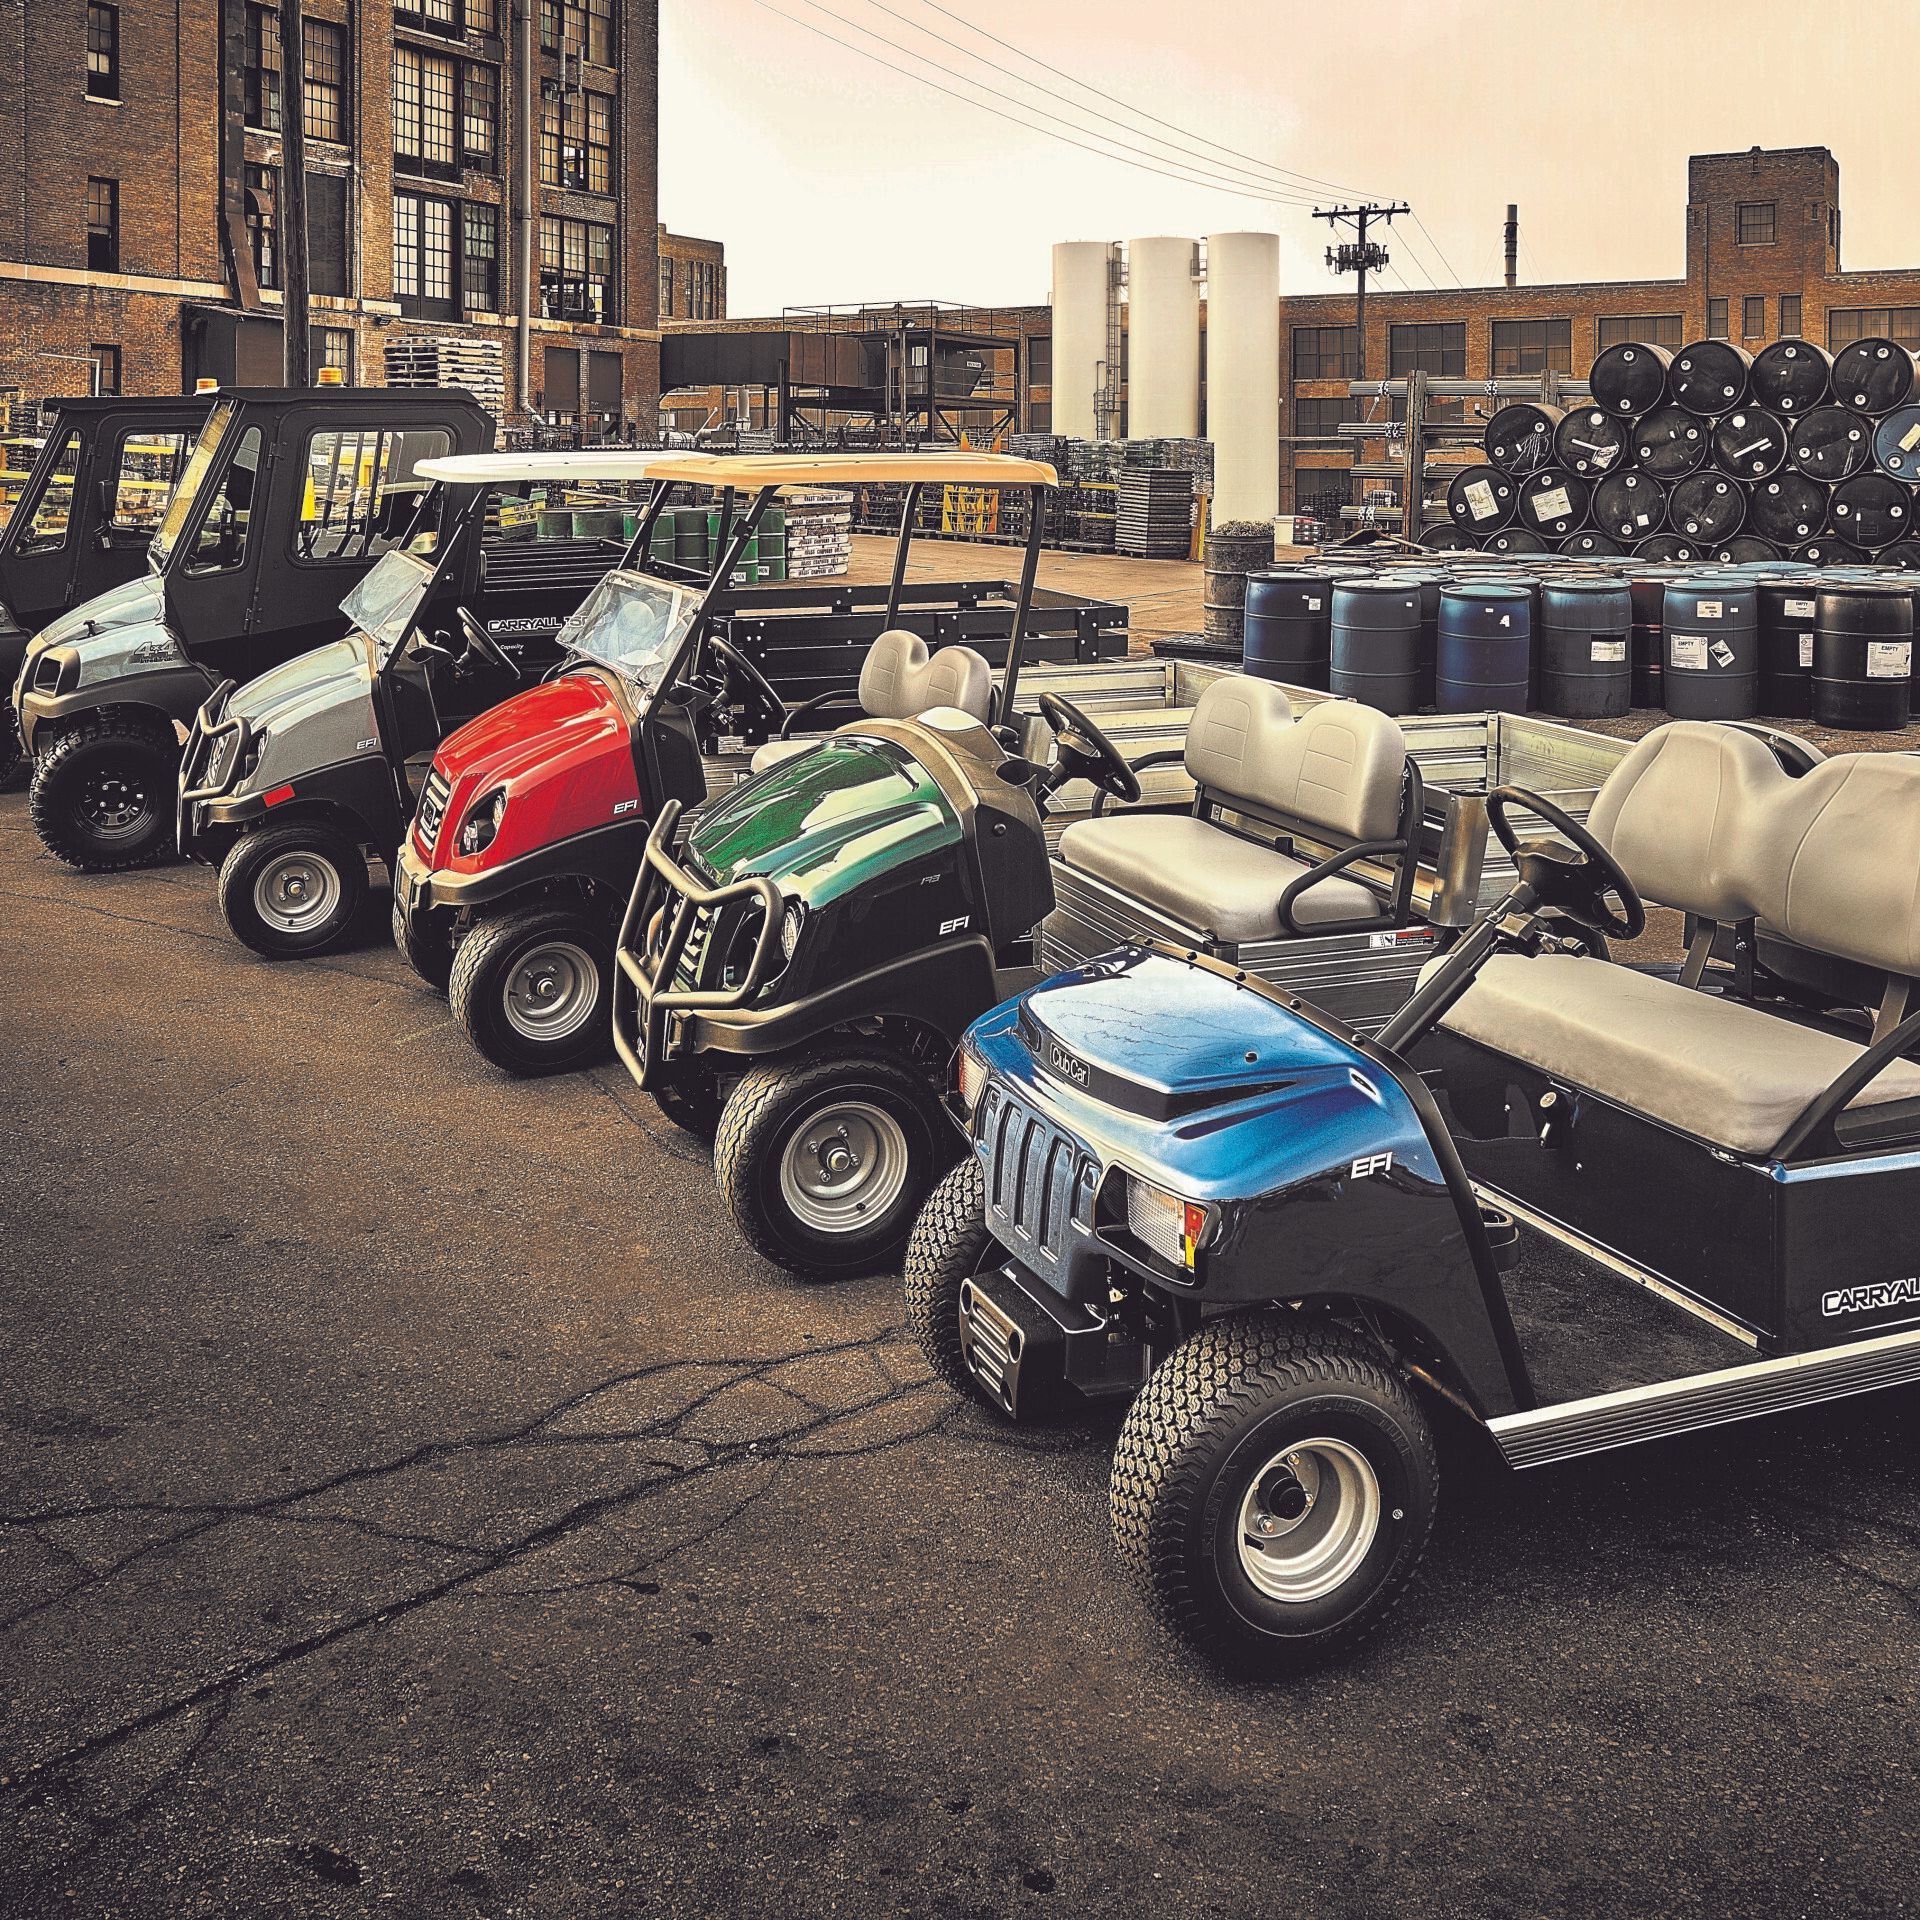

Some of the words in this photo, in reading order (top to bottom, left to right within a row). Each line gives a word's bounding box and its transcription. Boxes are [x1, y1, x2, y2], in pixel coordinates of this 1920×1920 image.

[488, 617, 562, 632] CARRYALL
[500, 643, 524, 651] Capacity
[356, 737, 377, 750] EFI
[613, 799, 638, 814] EFI
[939, 915, 970, 935] EFI
[1070, 1058, 1087, 1083] Car
[1350, 1151, 1393, 1180] EFI
[1822, 1278, 1920, 1316] CARRYAL
